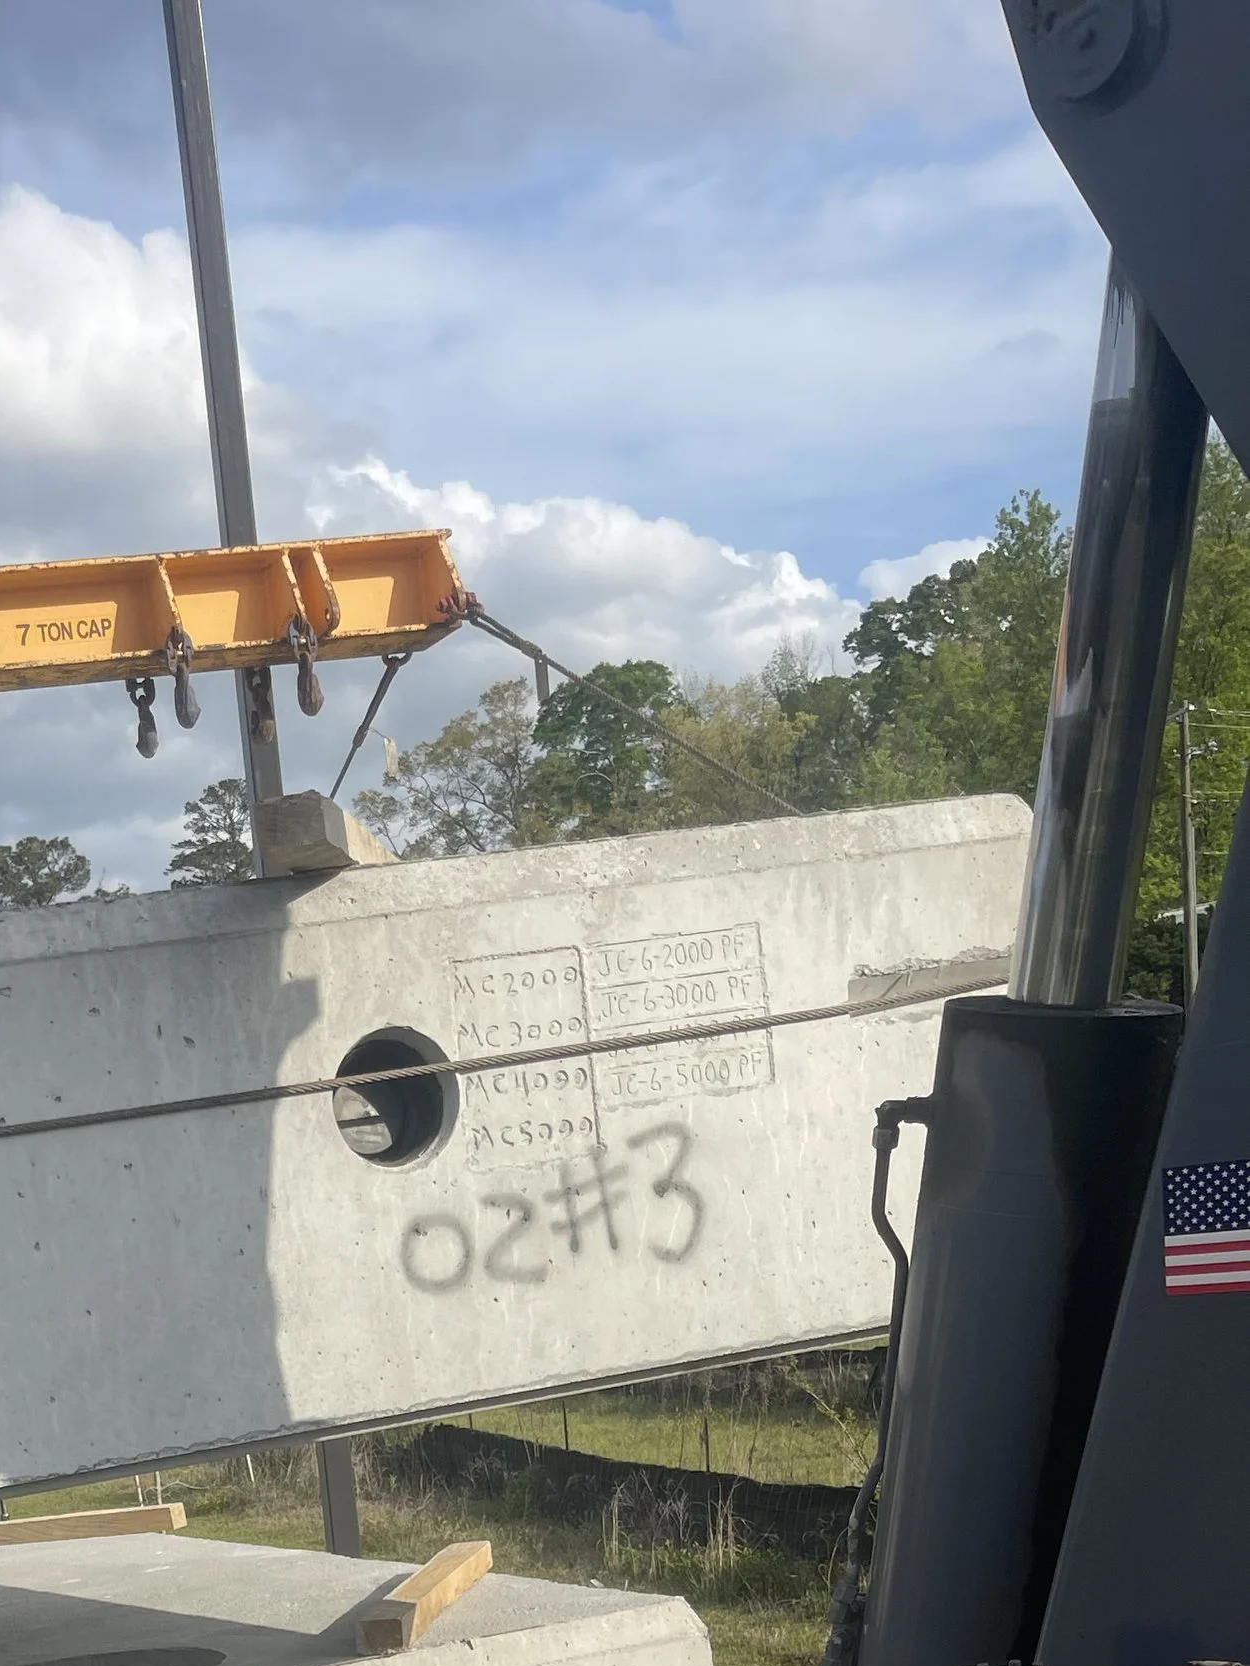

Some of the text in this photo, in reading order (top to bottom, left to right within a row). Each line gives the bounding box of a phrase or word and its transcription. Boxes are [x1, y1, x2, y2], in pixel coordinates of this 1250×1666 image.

[15, 618, 112, 646] 7 TON CAP
[721, 934, 744, 961] PF
[454, 966, 578, 1000] MC2000
[727, 975, 752, 1000] PF
[458, 1017, 582, 1050] MC3000
[739, 1052, 762, 1080] PF
[465, 1067, 588, 1107] MC4000
[472, 1117, 593, 1150] MC5000
